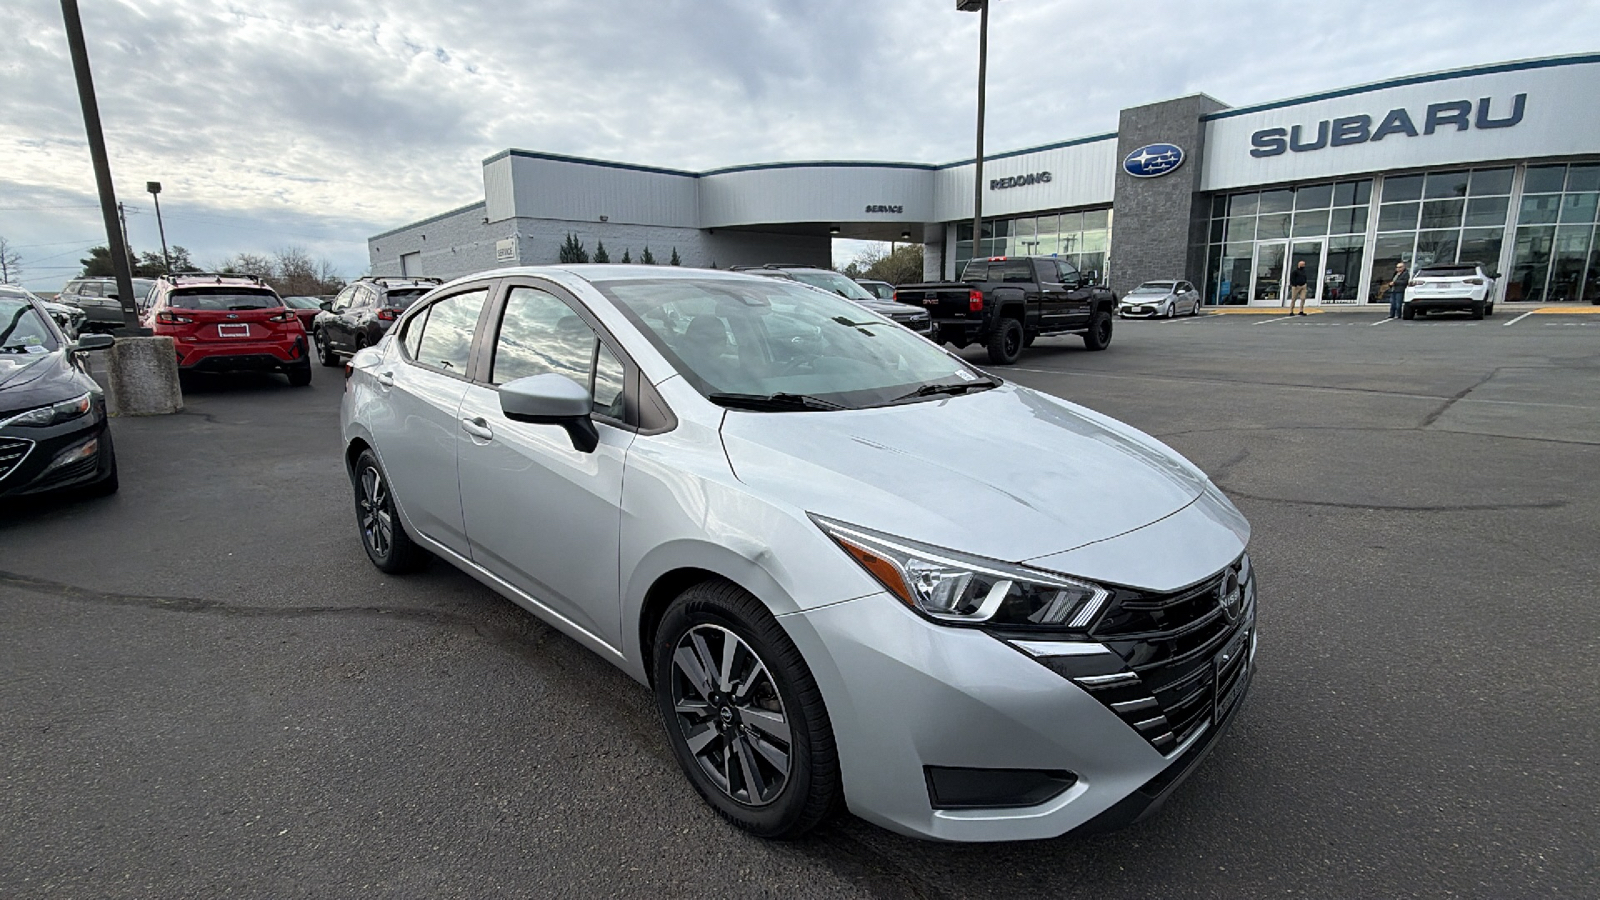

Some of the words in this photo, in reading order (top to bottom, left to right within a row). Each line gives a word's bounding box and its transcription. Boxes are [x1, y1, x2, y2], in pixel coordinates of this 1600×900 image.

[1250, 93, 1527, 158] SUBARU
[990, 171, 1052, 190] REDDING
[865, 204, 904, 214] SERVICE
[1220, 591, 1238, 608] NISS
